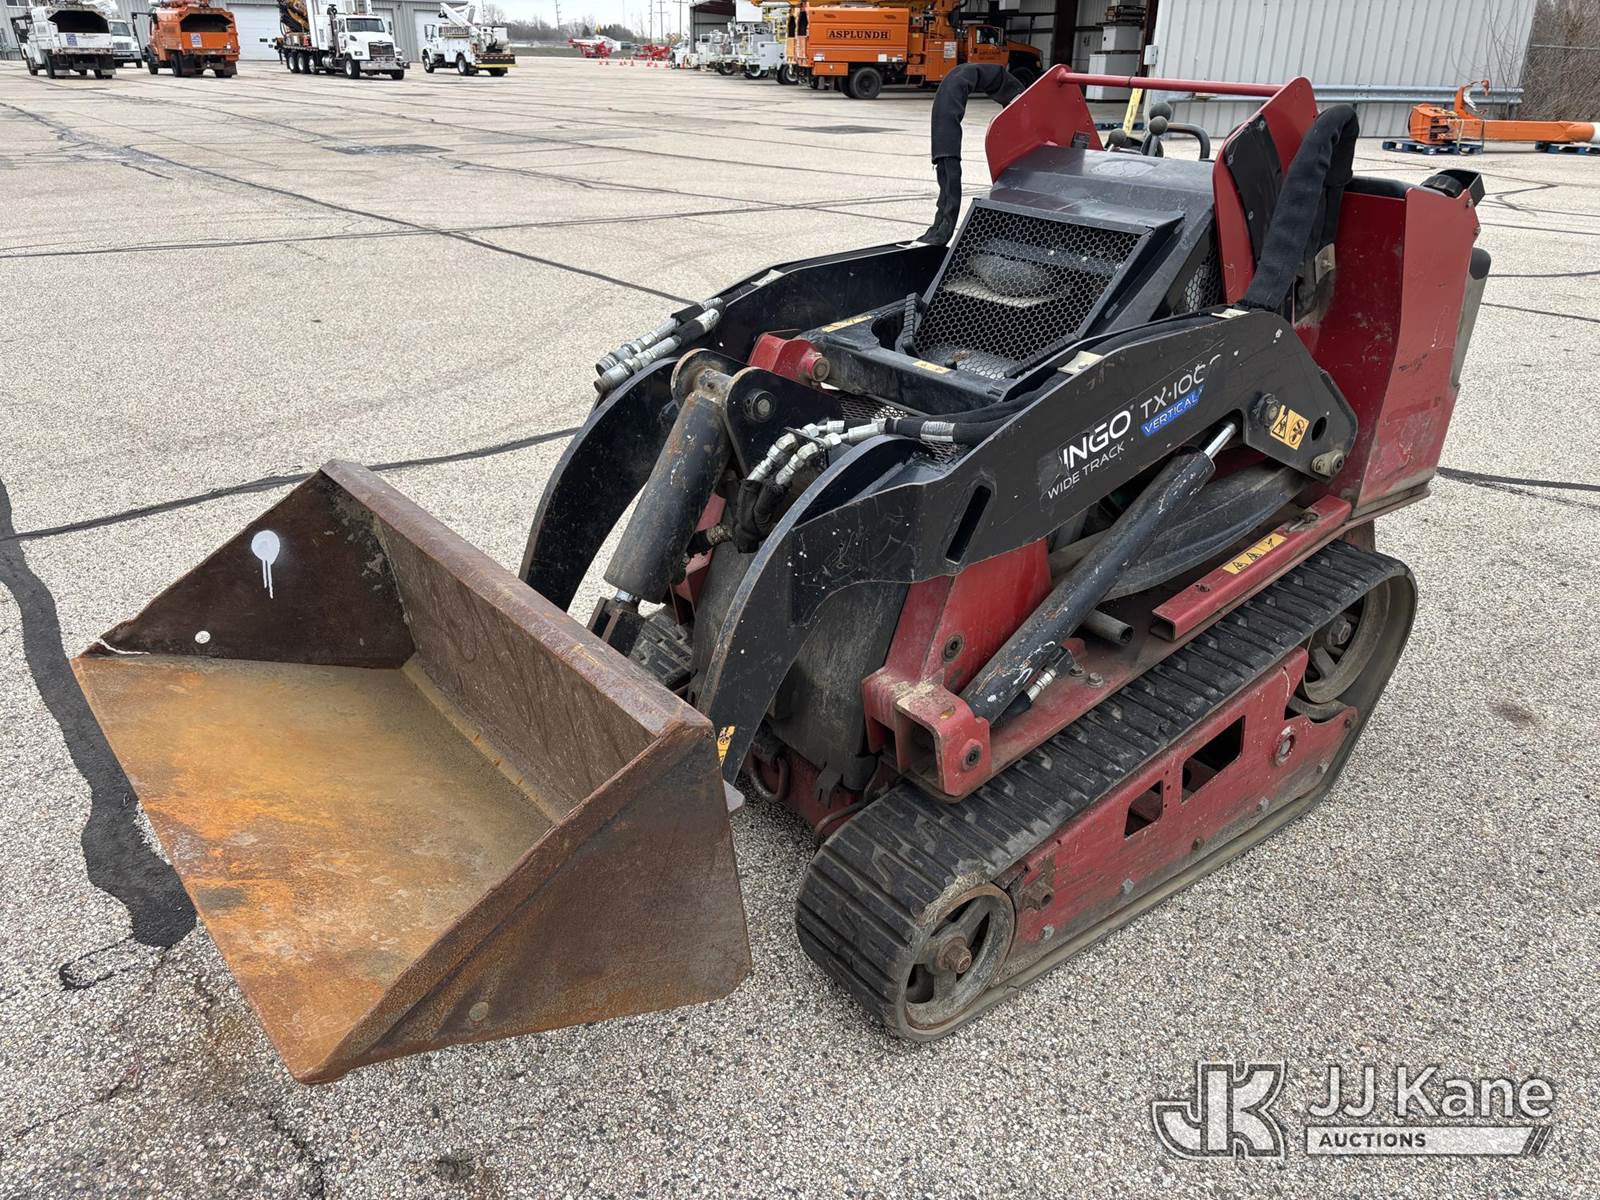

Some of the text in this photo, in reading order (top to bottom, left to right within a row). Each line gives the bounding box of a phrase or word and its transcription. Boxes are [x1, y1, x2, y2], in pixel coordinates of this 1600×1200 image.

[828, 30, 889, 39] ASPLUNDH
[1059, 410, 1131, 469] INGO
[1048, 440, 1125, 499] WIDE TRACK
